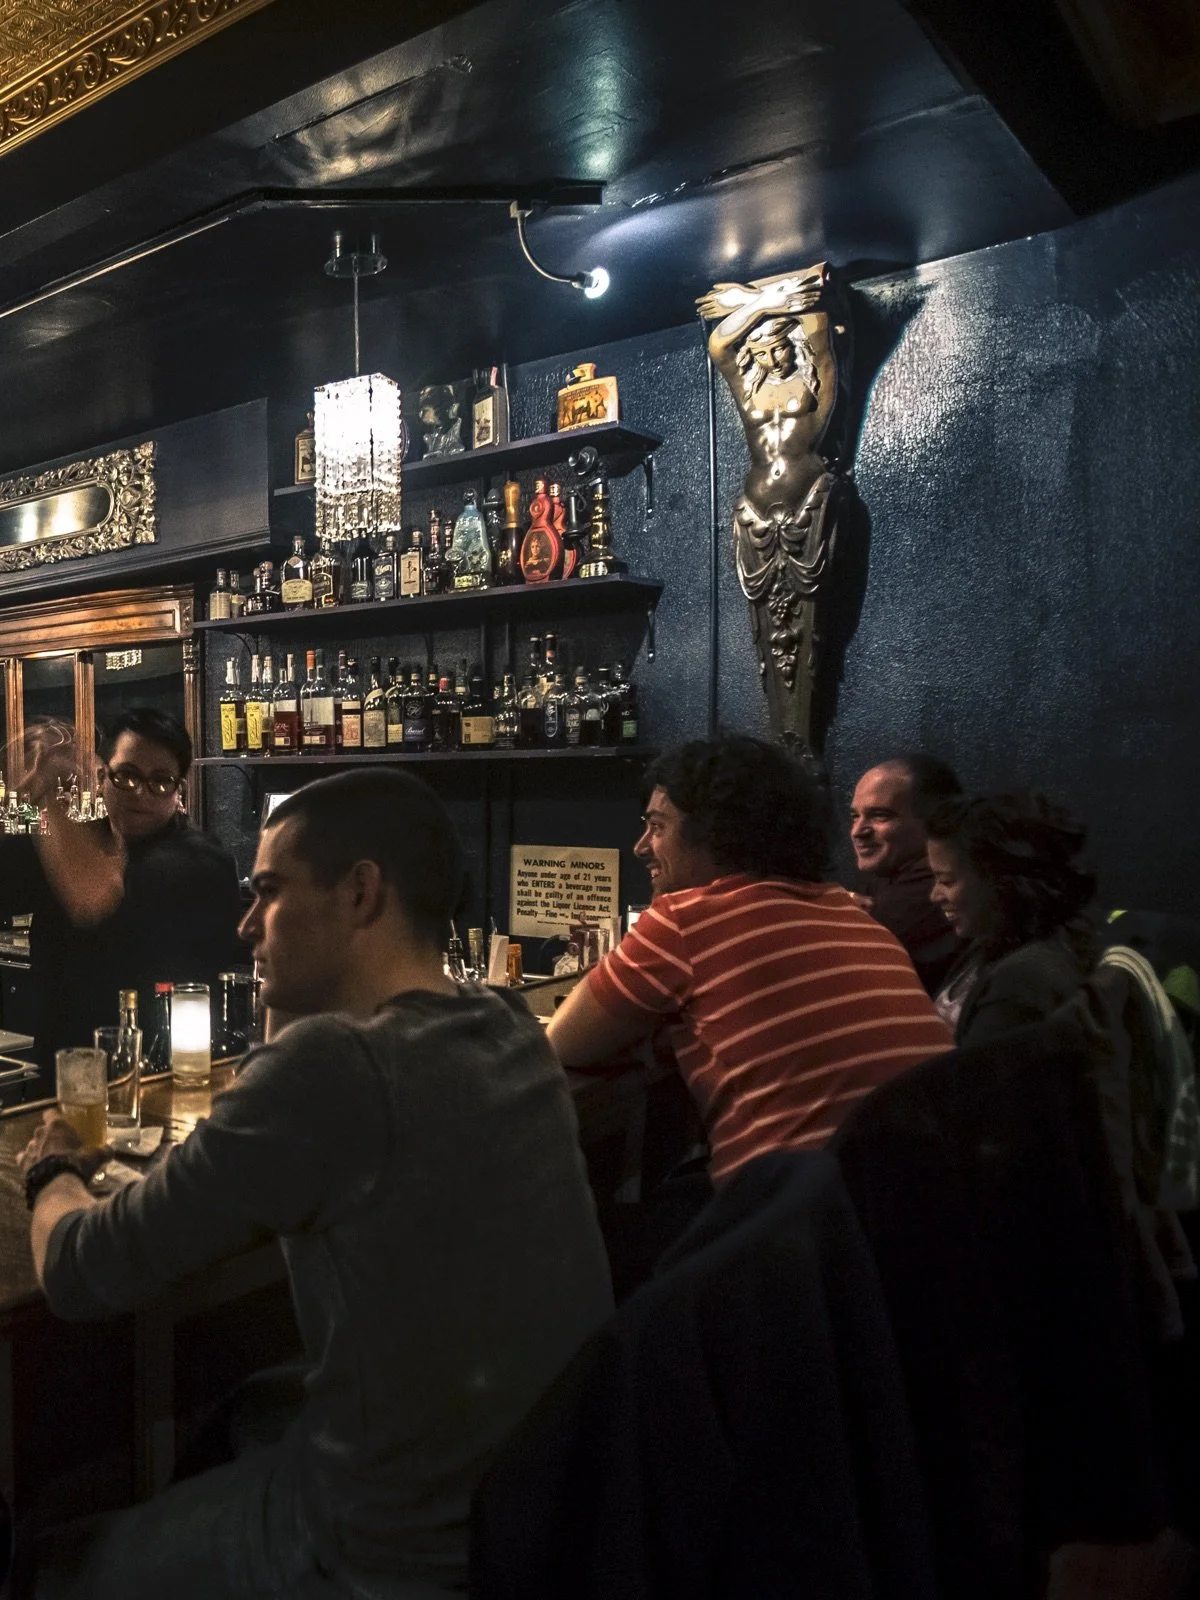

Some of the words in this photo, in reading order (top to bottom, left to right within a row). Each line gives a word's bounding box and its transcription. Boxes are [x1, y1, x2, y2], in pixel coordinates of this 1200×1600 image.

[523, 859, 565, 867] WARNING
[570, 861, 605, 870] MINORS
[517, 870, 538, 878] Anyone
[532, 880, 555, 888] ENTERS
[566, 883, 593, 892] beverage
[545, 891, 563, 900] guilty
[587, 894, 611, 902] offence
[517, 899, 538, 908] against
[553, 901, 571, 910] Liquor
[573, 903, 596, 911] Licence
